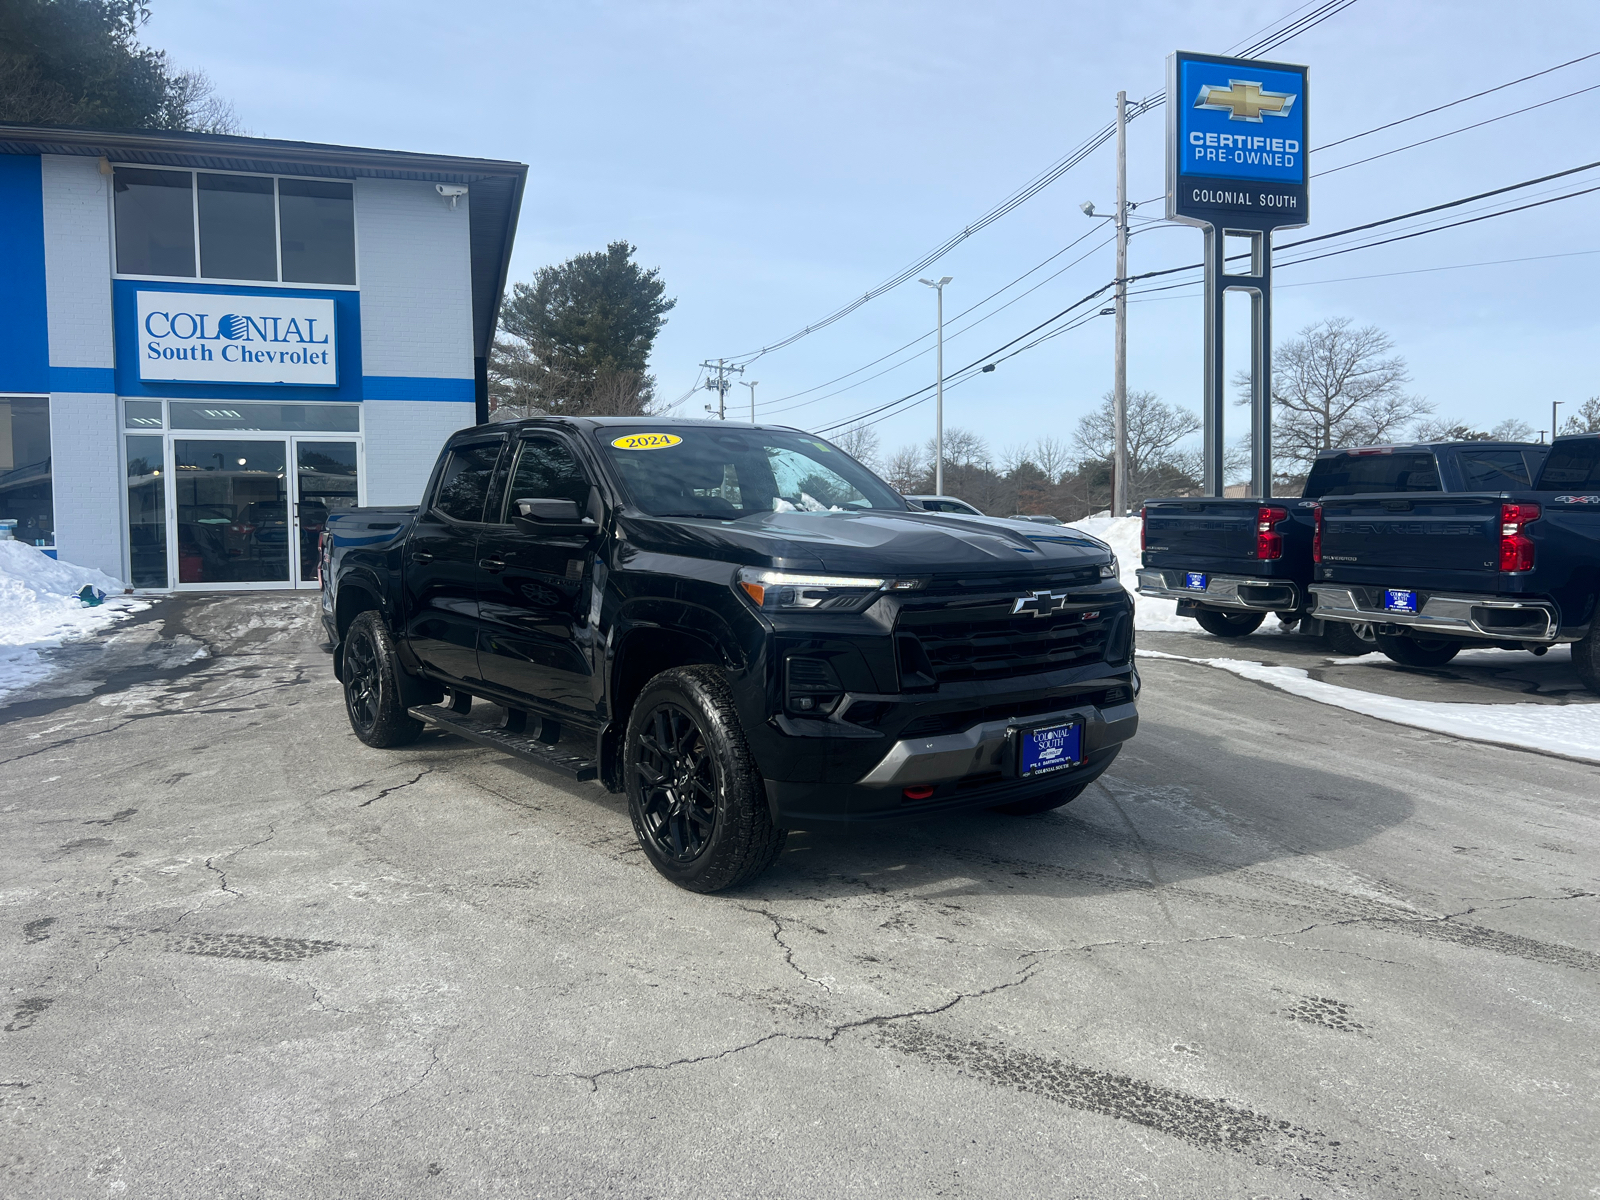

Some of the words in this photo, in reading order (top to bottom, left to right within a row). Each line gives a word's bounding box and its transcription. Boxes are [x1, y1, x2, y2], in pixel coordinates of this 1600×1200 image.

[1190, 131, 1299, 153] CERTIFIED
[1195, 148, 1294, 167] PRE-OWNED
[1192, 189, 1252, 205] COLONIAL
[1259, 194, 1297, 208] SOUTH
[145, 311, 329, 344] COLONIAL
[147, 341, 214, 361] South
[221, 344, 329, 365] Chevrolet
[626, 435, 671, 448] 2024
[1033, 729, 1070, 743] COLONIAL
[1039, 738, 1064, 750] SOUTH
